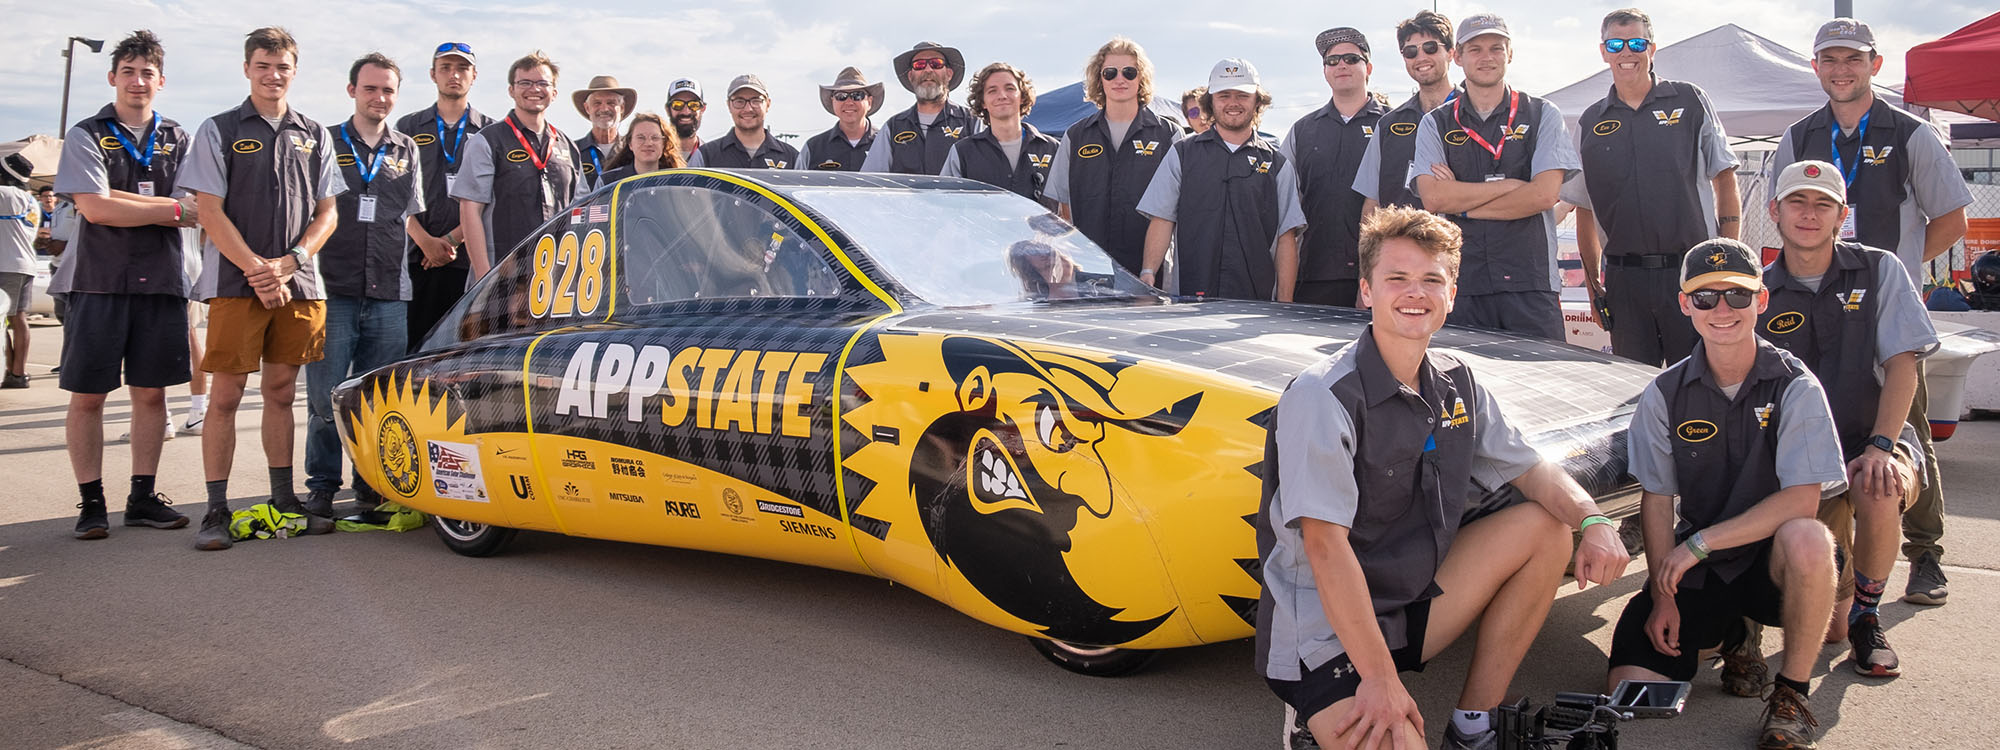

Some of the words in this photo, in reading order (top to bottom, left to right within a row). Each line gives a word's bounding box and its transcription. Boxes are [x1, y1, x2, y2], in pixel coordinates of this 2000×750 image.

[529, 228, 606, 319] 828
[1776, 316, 1796, 329] Reid
[1685, 425, 1709, 436] Green
[609, 492, 645, 504] MITSUBA
[758, 501, 803, 517] BRIDGESTONE
[779, 519, 837, 540] SIEMENS
